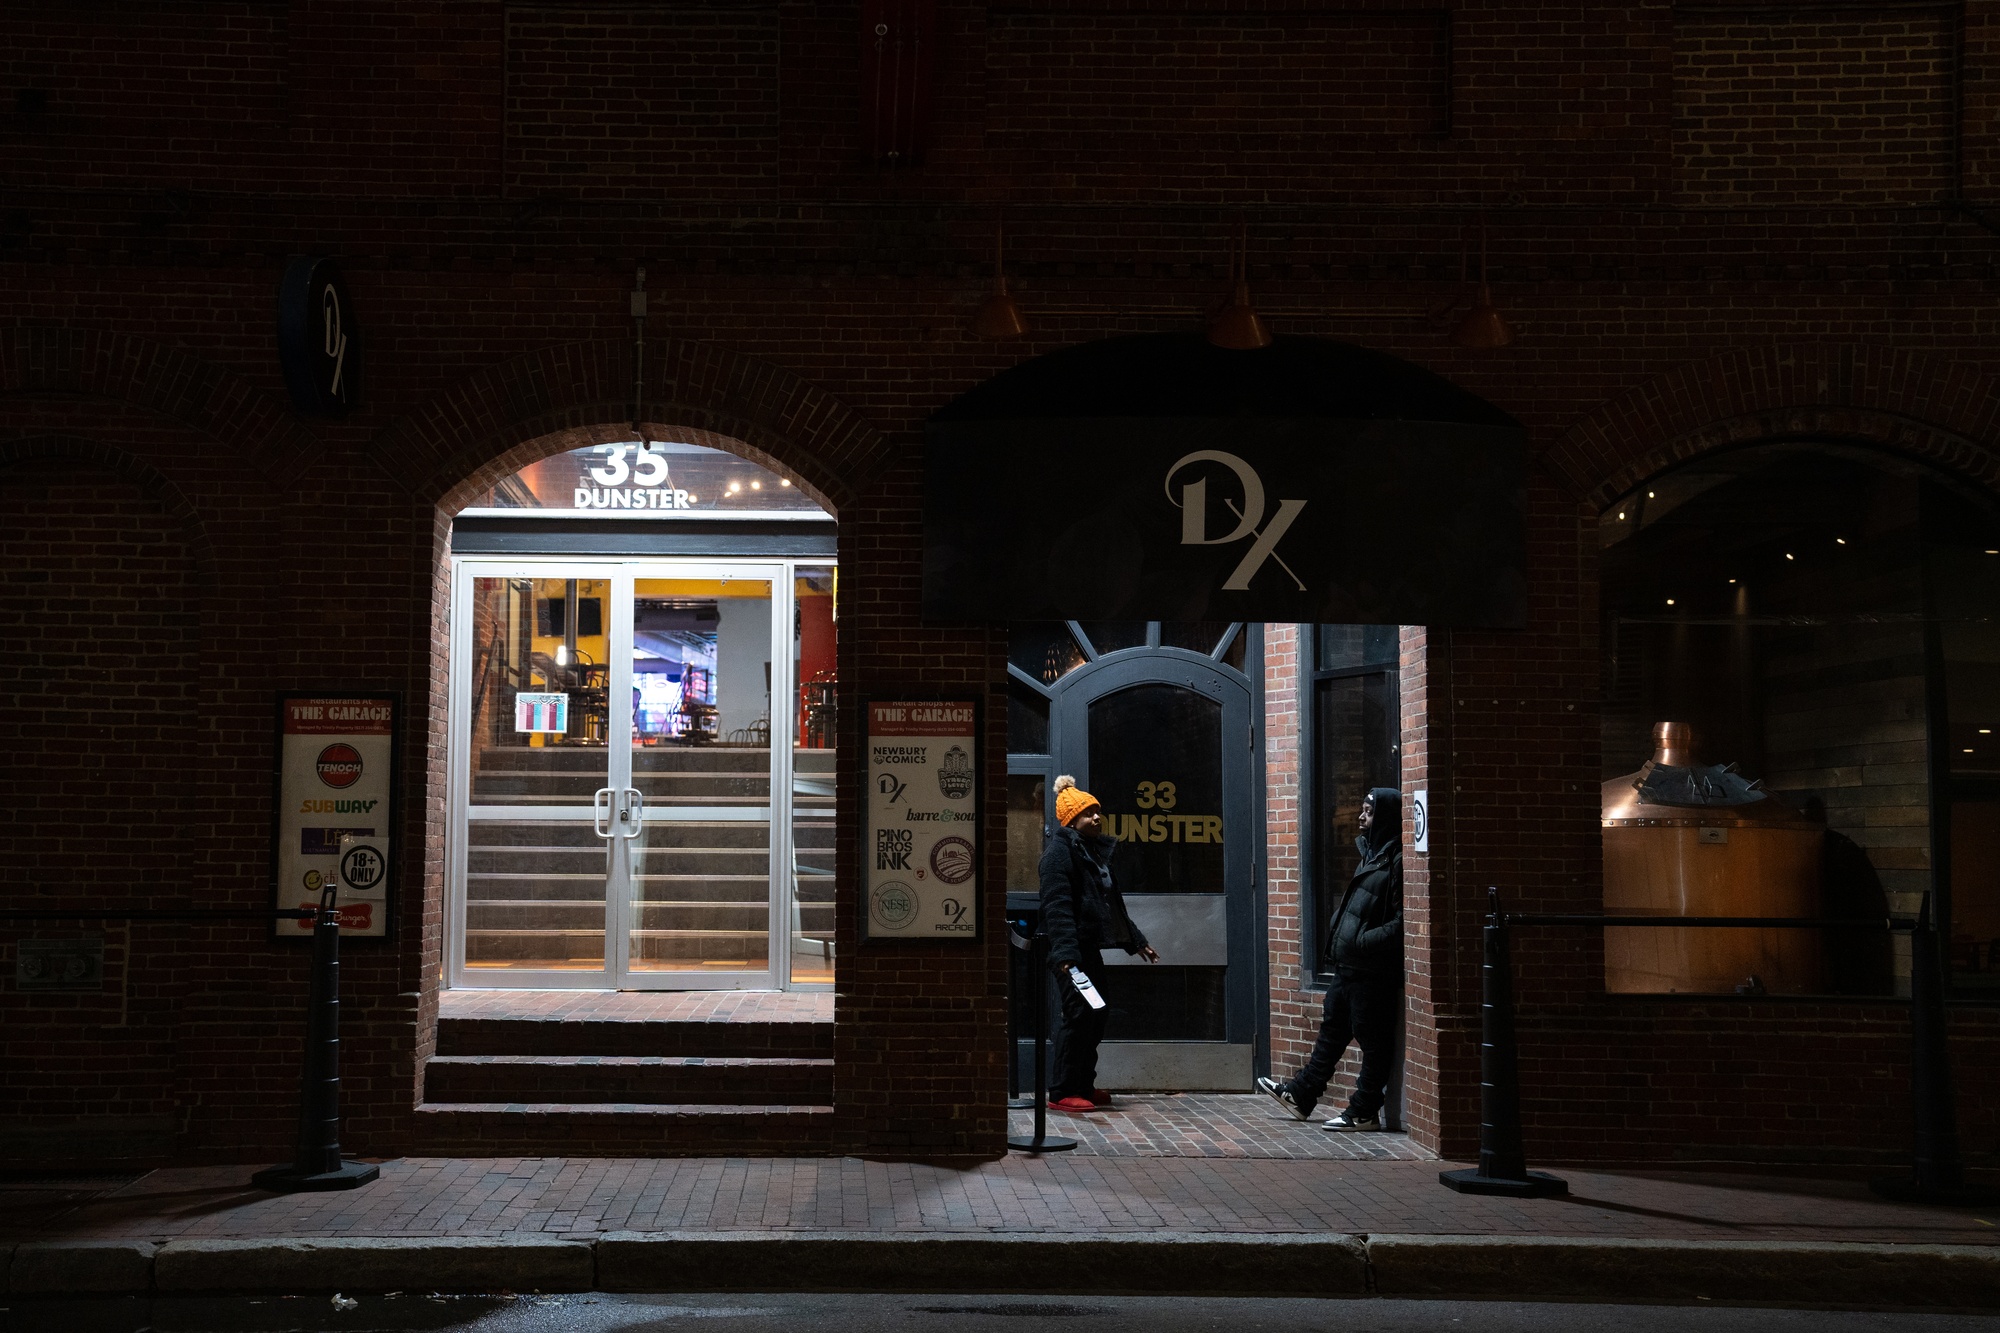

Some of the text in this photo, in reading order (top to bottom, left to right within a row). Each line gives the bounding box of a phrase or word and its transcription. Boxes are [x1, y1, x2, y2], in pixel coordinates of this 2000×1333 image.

[590, 441, 669, 486] 35
[574, 488, 690, 509] DUNSTER
[291, 706, 391, 720] THE GARAGE
[874, 708, 973, 722] THE GARAGE
[873, 747, 927, 755] NEWBURY
[885, 756, 926, 764] COMICS
[318, 763, 361, 773] TENOCH
[1136, 780, 1177, 809] 33
[300, 800, 378, 814] SUBWAY
[877, 829, 912, 841] PINO
[877, 842, 912, 852] BROS
[351, 852, 376, 867] 18+
[877, 852, 912, 870] INK
[350, 867, 375, 882] ONLY
[881, 898, 909, 912] NESE
[333, 910, 367, 925] Burger
